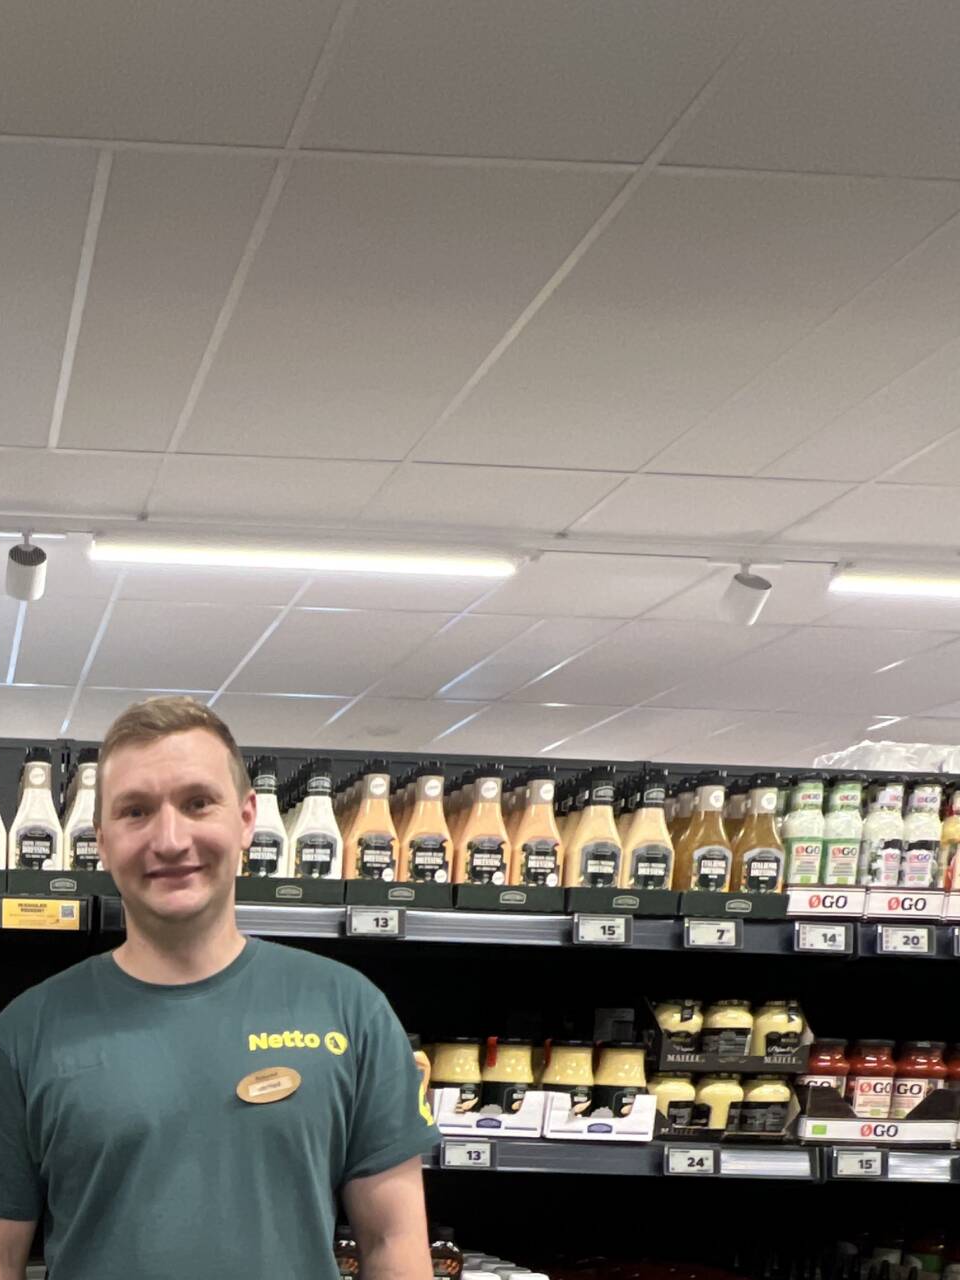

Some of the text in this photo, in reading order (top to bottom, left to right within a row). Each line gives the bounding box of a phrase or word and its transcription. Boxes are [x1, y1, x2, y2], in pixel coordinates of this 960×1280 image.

[795, 845, 820, 855] ØGO
[831, 847, 857, 856] ØGO
[909, 854, 931, 862] ØGO
[808, 895, 848, 909] ØGO
[887, 897, 927, 911] ØGO
[373, 917, 389, 928] 13
[600, 925, 616, 936] 15
[716, 929, 726, 940] 7
[821, 933, 837, 944] 14
[902, 935, 920, 946] 20
[248, 1030, 321, 1052] Netto
[666, 1054, 701, 1063] MAILLE
[764, 1056, 798, 1064] MAILLE
[859, 1081, 891, 1094] ØGO
[896, 1083, 922, 1095] GO
[860, 1124, 899, 1137] ØGO
[465, 1149, 483, 1162] 13
[687, 1157, 705, 1167] 24
[858, 1159, 873, 1170] 15
